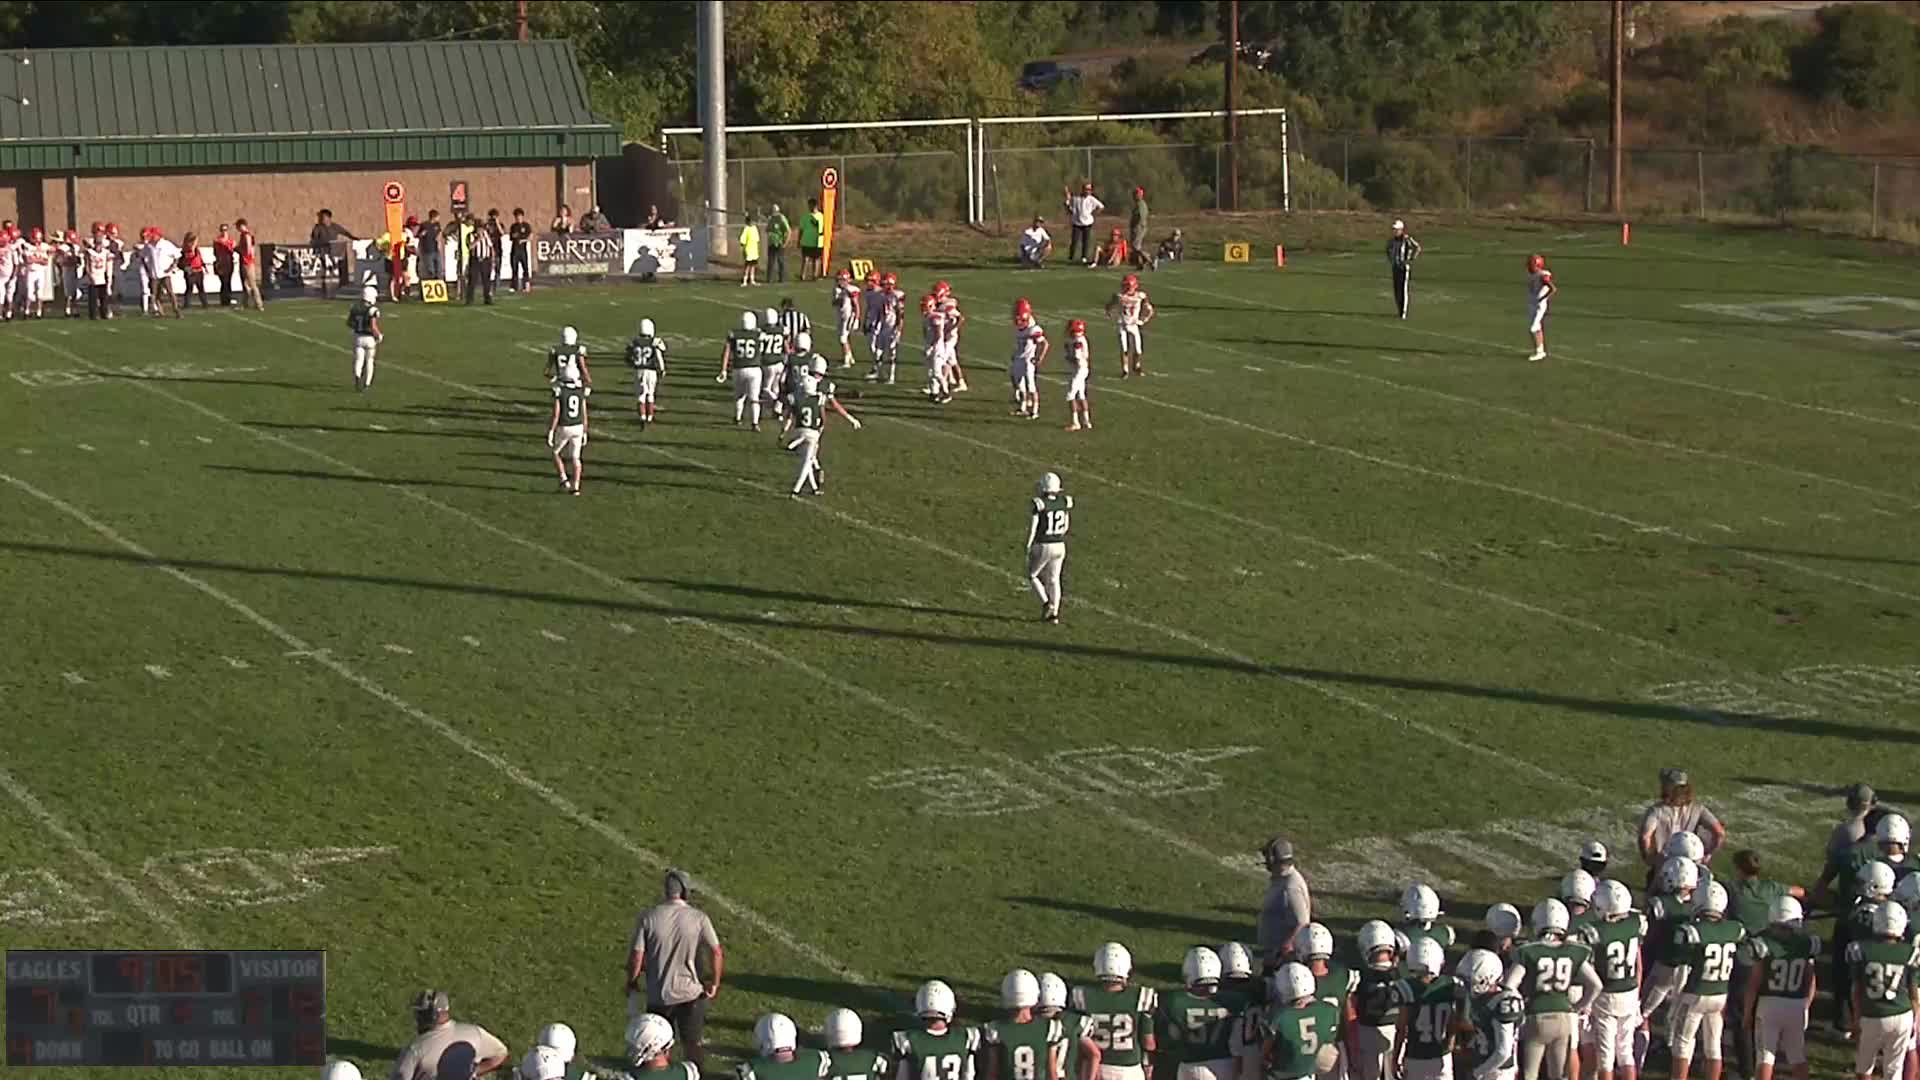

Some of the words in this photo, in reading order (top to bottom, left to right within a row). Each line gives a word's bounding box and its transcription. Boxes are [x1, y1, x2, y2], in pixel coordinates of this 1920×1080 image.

[452, 183, 465, 202] 4
[538, 239, 620, 260] BARTON
[1230, 244, 1243, 259] G
[423, 281, 445, 300] 20
[633, 346, 652, 366] 32
[735, 338, 756, 359] 56
[567, 394, 581, 419] 9
[801, 406, 813, 427] 3
[1045, 510, 1066, 535] 12
[1536, 956, 1574, 992] 29
[1701, 943, 1737, 981] 26
[1767, 958, 1805, 992] 30
[1864, 962, 1904, 1000] 37
[1093, 1013, 1134, 1050] 52
[1186, 1007, 1228, 1043] 57
[1298, 1016, 1319, 1055] 5
[1014, 1045, 1035, 1080] 8
